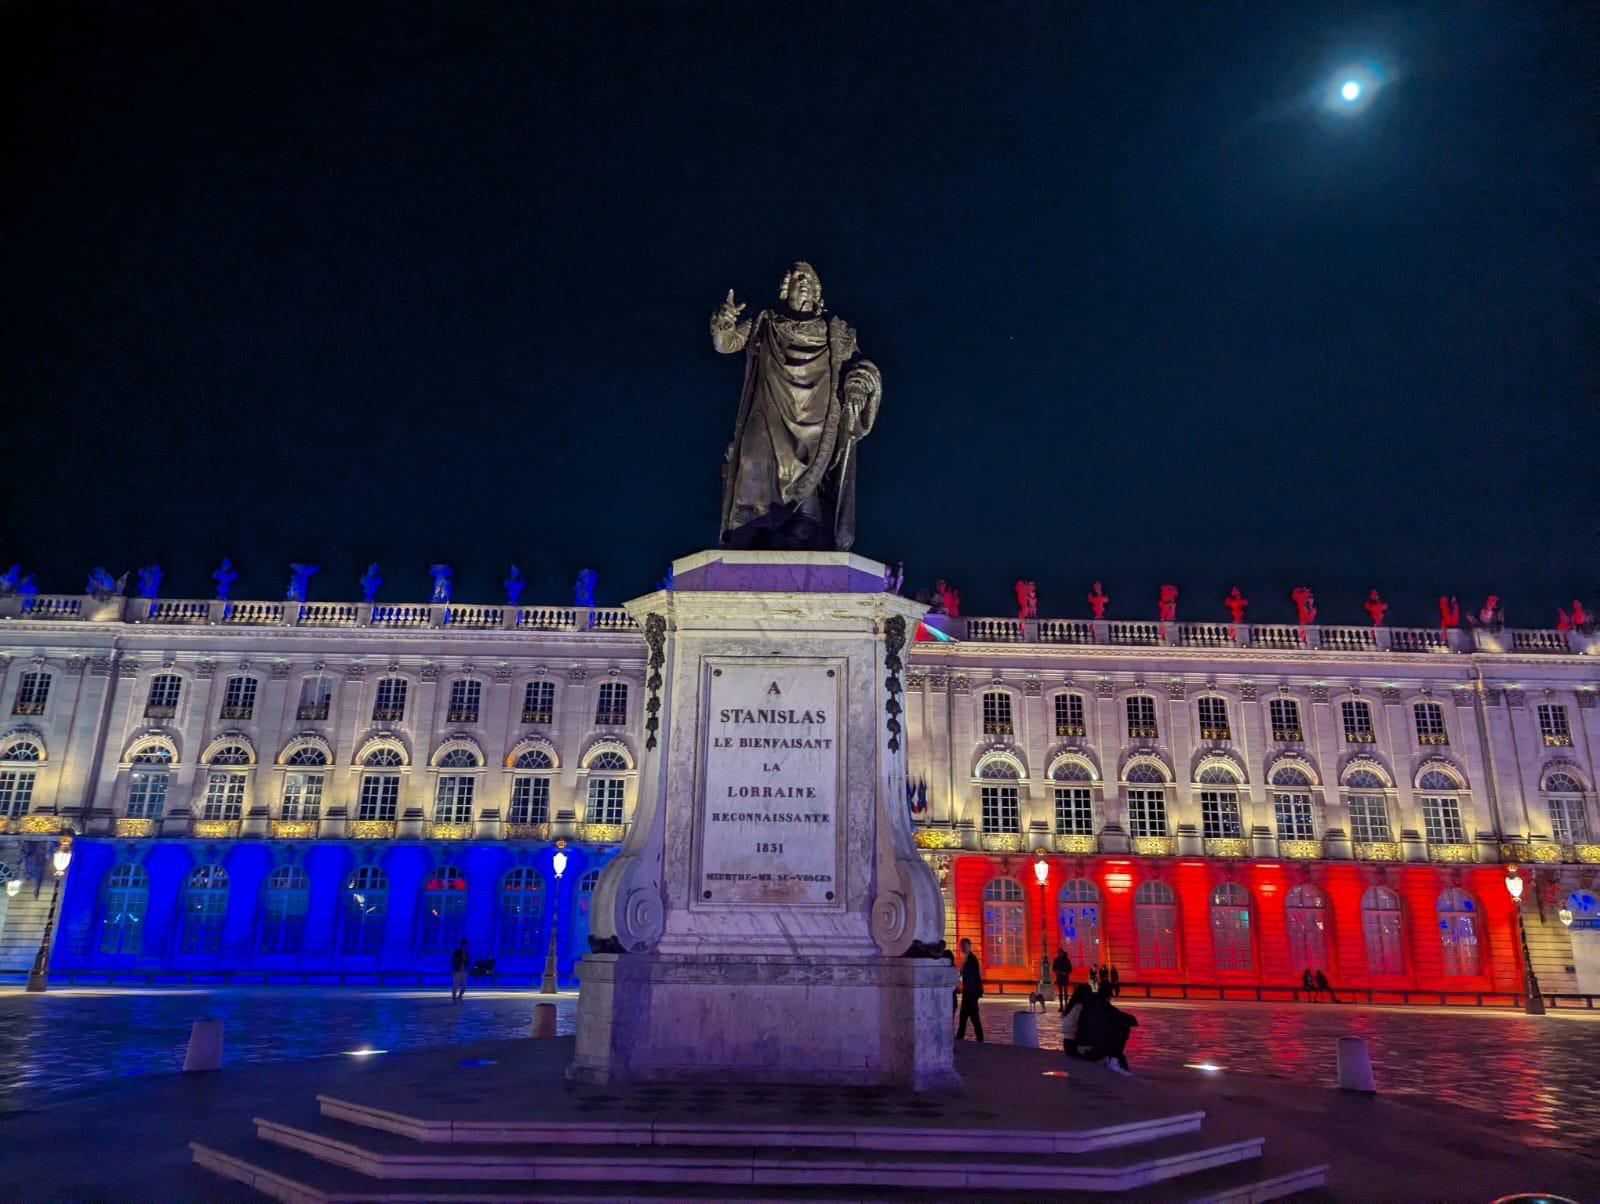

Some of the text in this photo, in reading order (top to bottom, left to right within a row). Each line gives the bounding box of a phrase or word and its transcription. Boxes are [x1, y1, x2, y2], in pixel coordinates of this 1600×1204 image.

[767, 681, 781, 695] A
[720, 709, 826, 724] STANISLAS
[713, 738, 832, 749] LE BIENFAISANT
[763, 763, 781, 772] LA
[727, 786, 816, 798] LORRAINE
[712, 812, 830, 823] RECONNAISSANTE
[756, 842, 784, 853] 1831
